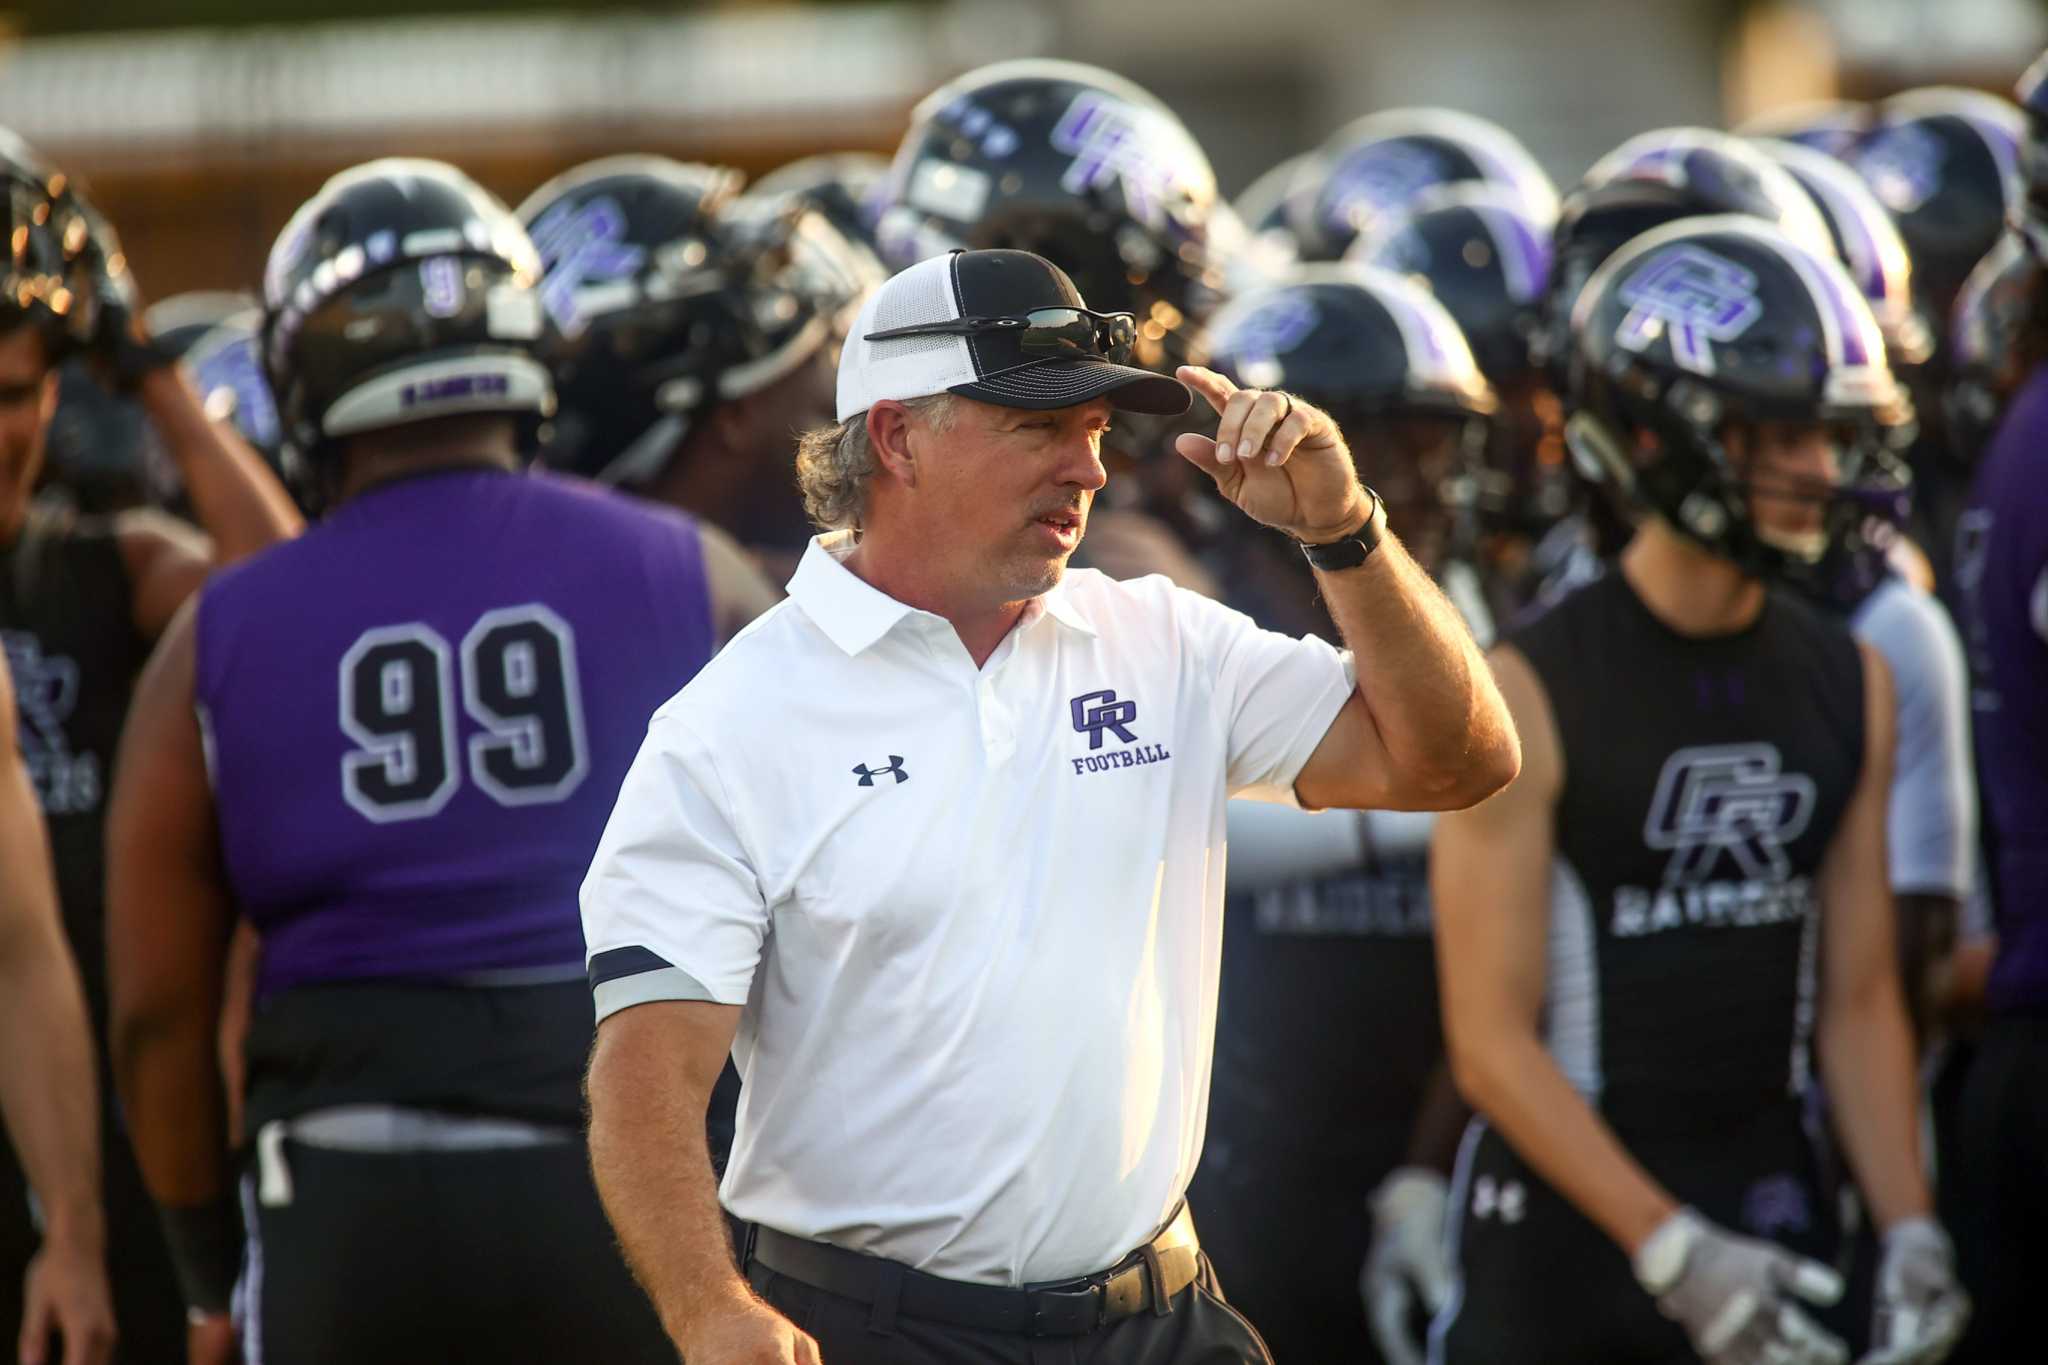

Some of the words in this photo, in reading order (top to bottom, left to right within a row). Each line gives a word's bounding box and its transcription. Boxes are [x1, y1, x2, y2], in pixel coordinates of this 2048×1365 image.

[339, 602, 590, 824] 99
[1070, 689, 1138, 751] CR
[1071, 743, 1171, 776] FOOTBALL
[1643, 742, 1818, 893] CR
